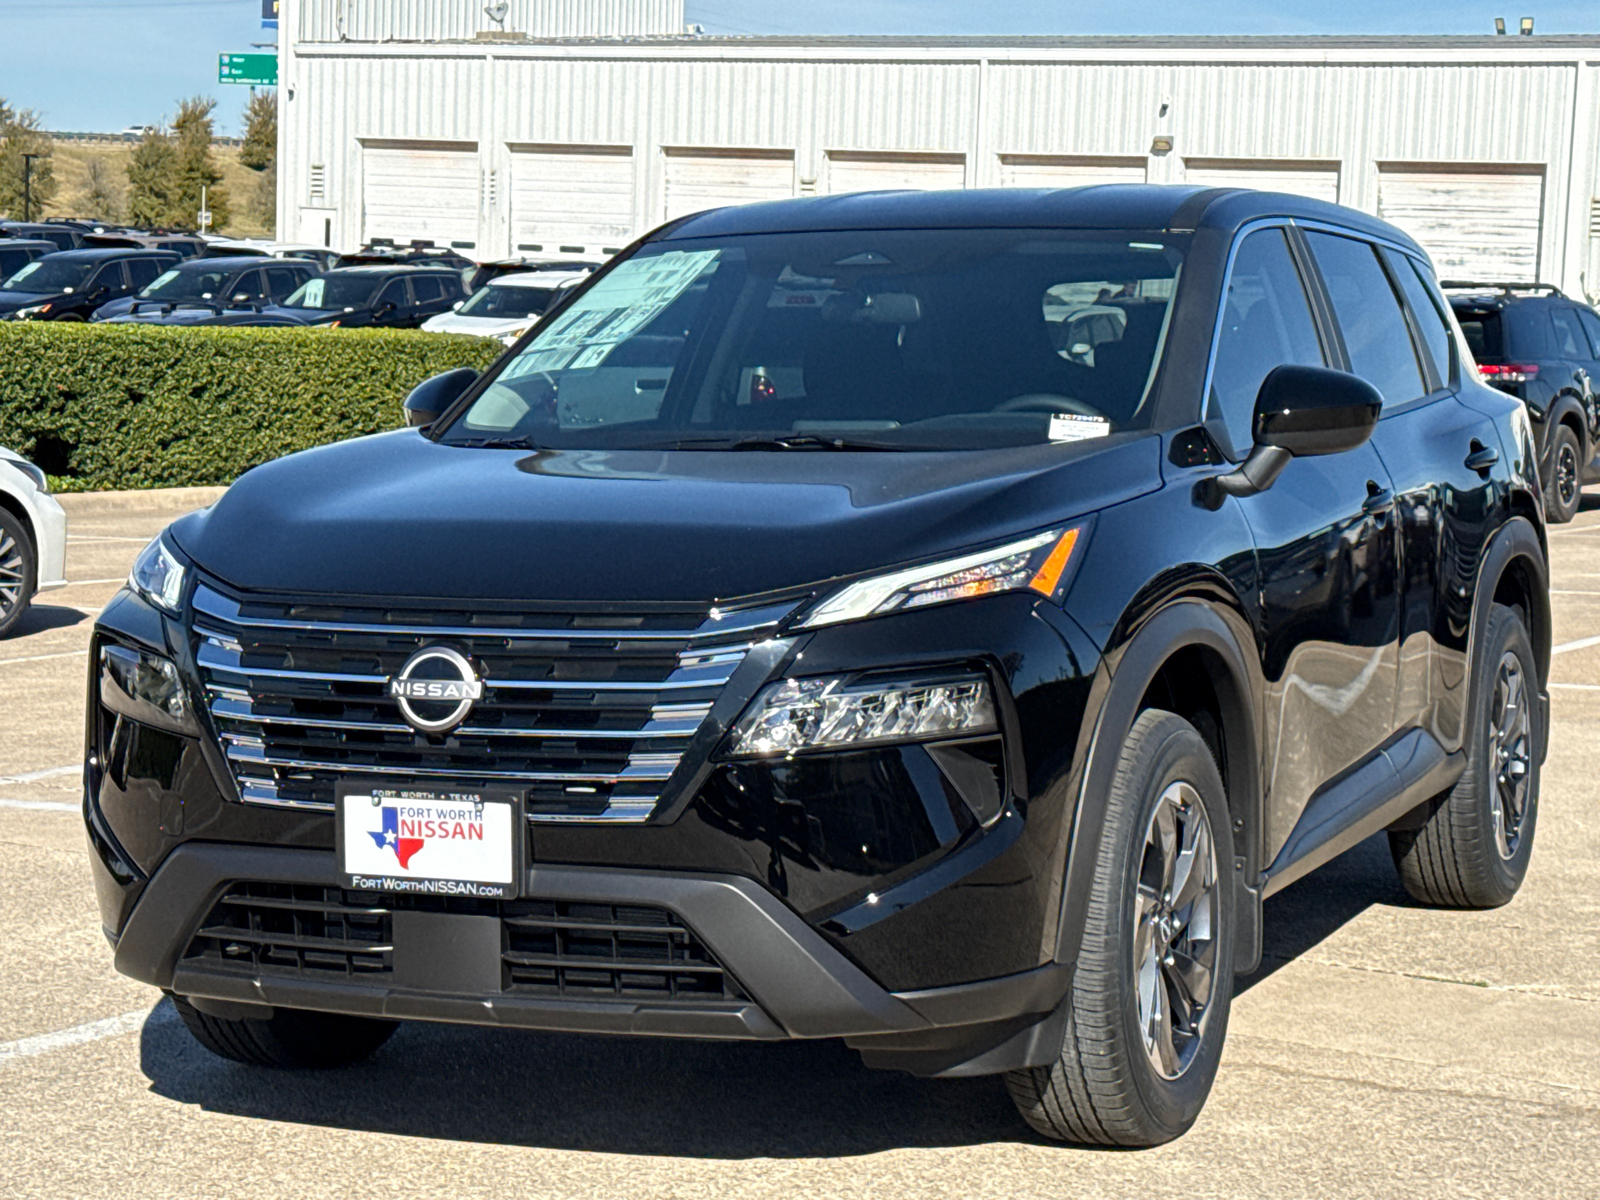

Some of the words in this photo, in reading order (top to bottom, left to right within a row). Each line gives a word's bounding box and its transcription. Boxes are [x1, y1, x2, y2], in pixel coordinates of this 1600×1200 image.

[391, 681, 478, 698] NISSAN
[372, 789, 397, 798] FORT
[401, 791, 435, 800] WORTH
[449, 793, 481, 803] TEXAS
[400, 807, 432, 819] FORT
[436, 808, 483, 821] WORTH
[401, 819, 483, 841] NISSAN
